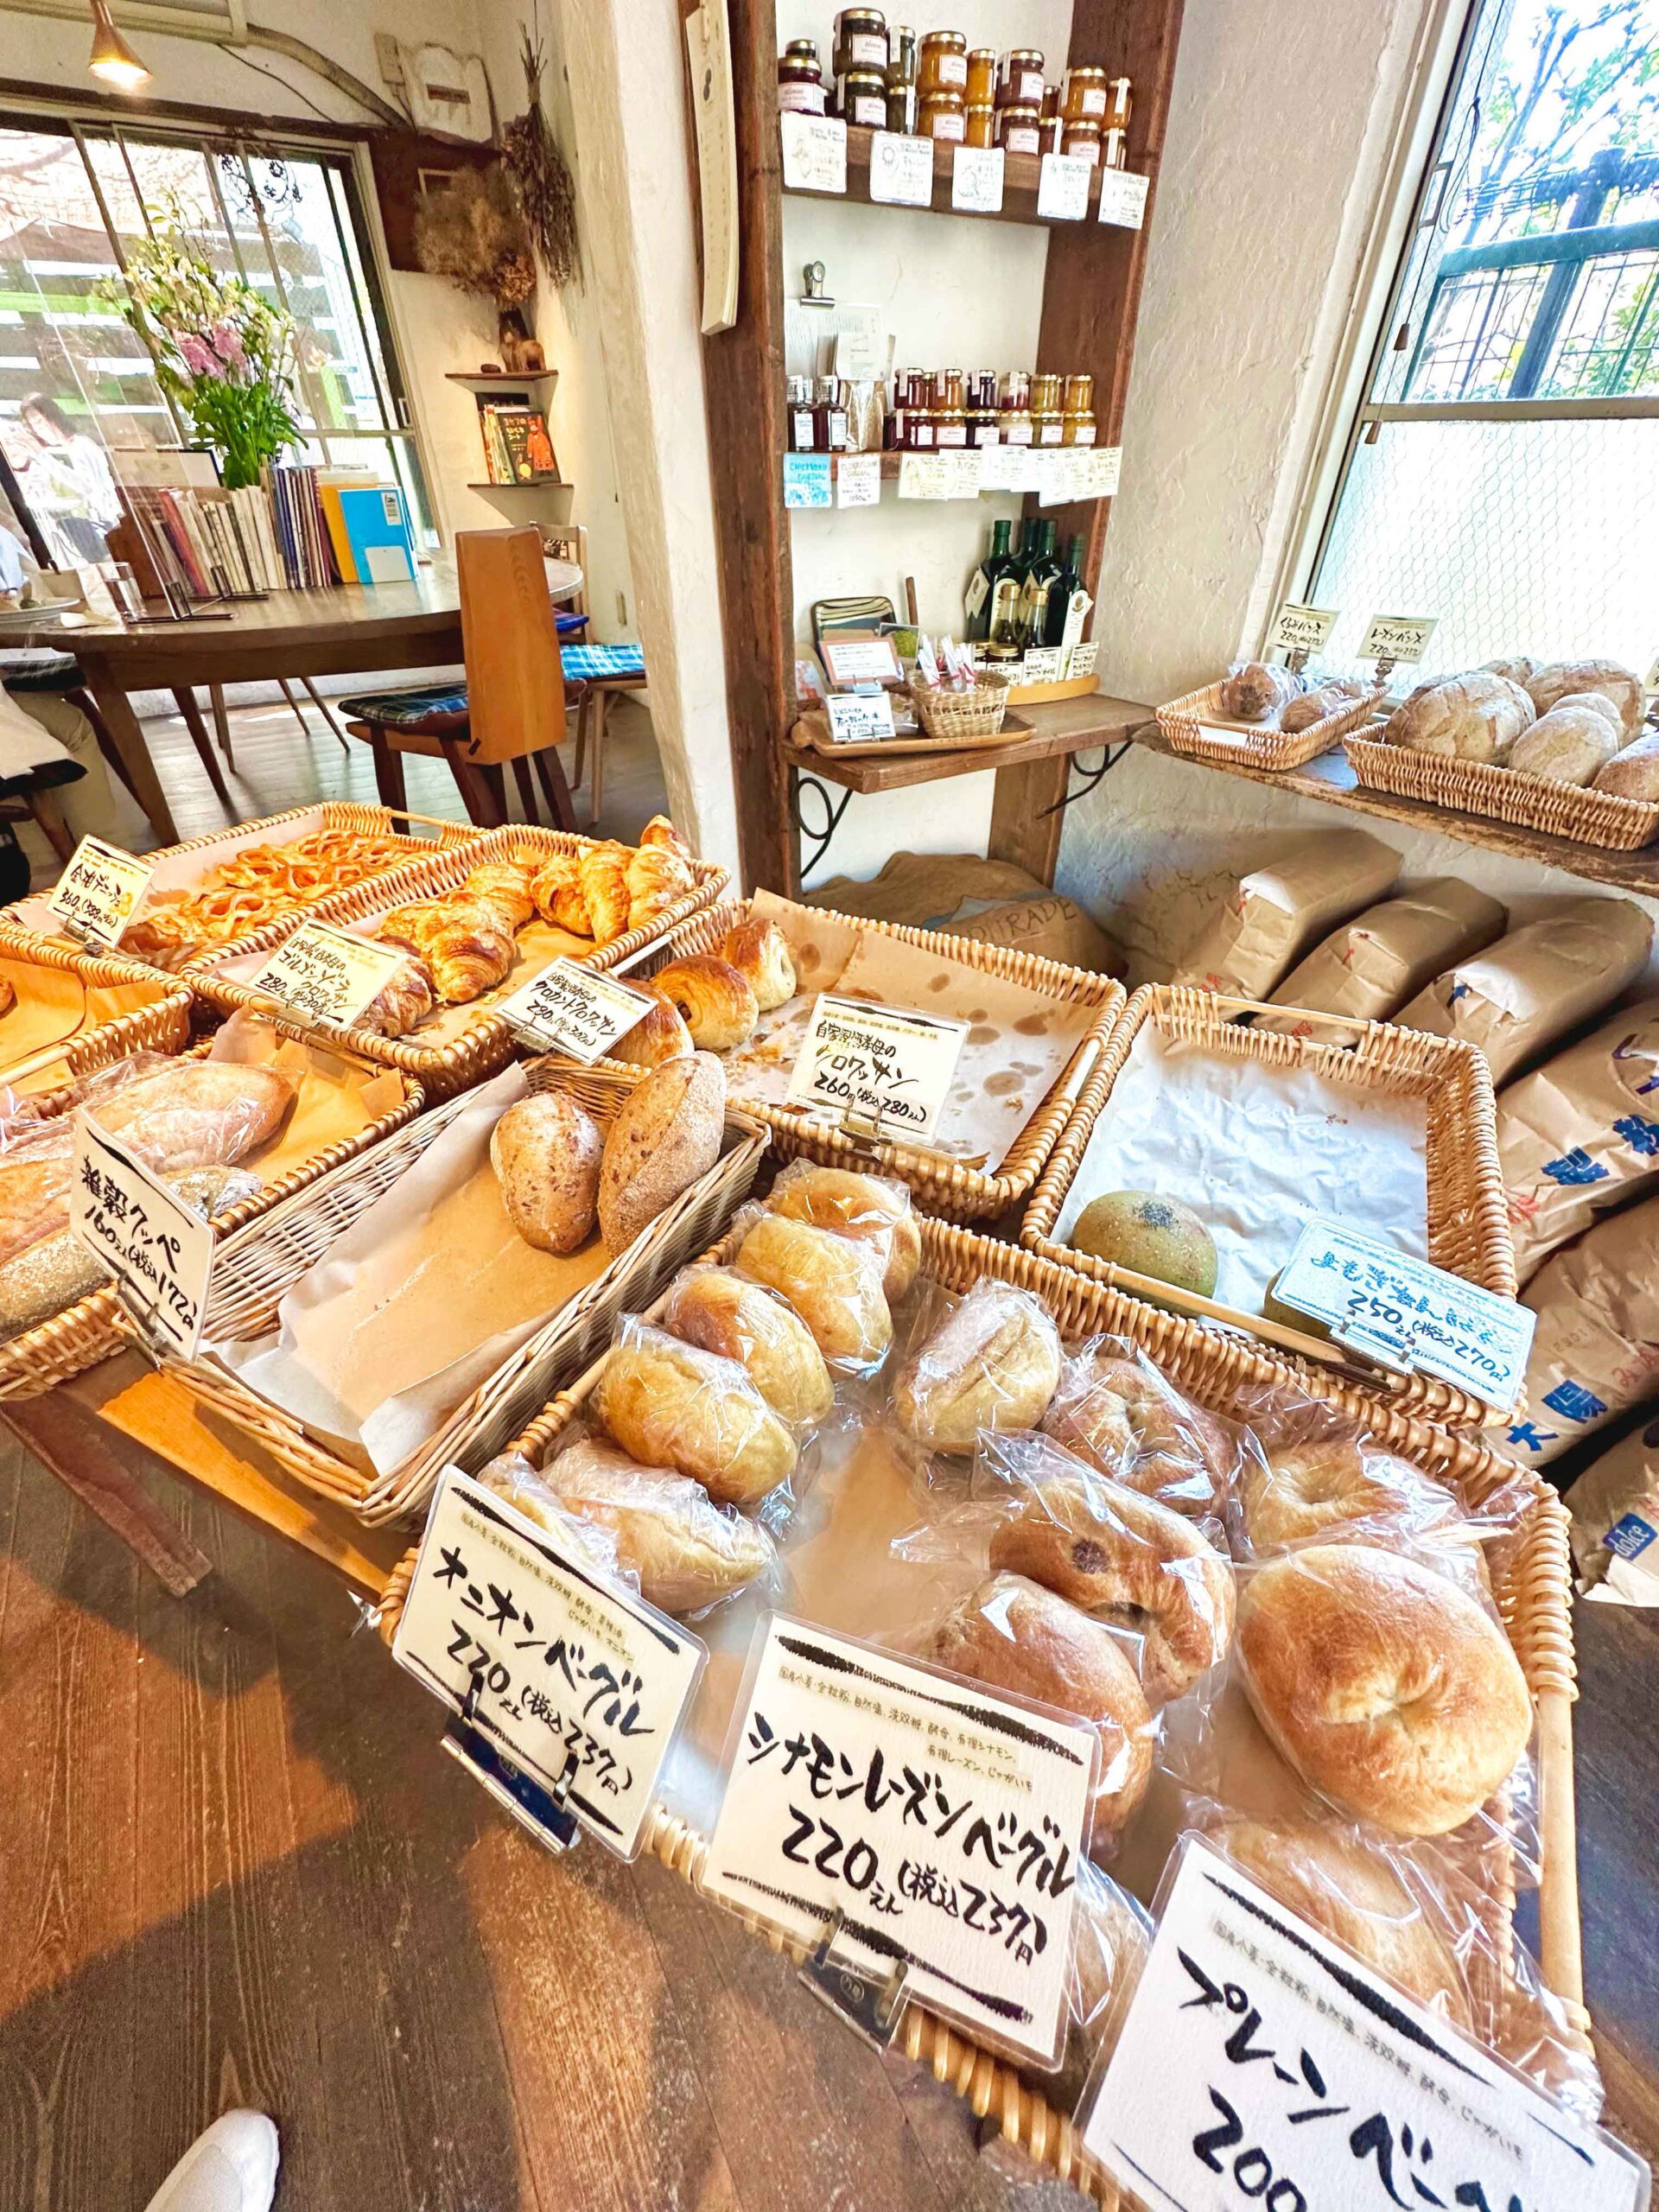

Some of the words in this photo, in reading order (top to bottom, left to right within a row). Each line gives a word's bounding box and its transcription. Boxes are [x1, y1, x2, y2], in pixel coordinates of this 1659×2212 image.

[1370, 628, 1426, 644] レーズンバンズ
[1608, 1525, 1649, 1556] dolce
[432, 1547, 655, 1736] オニオンベーグル
[747, 1711, 1077, 1899] シナモンレーズンベーグル
